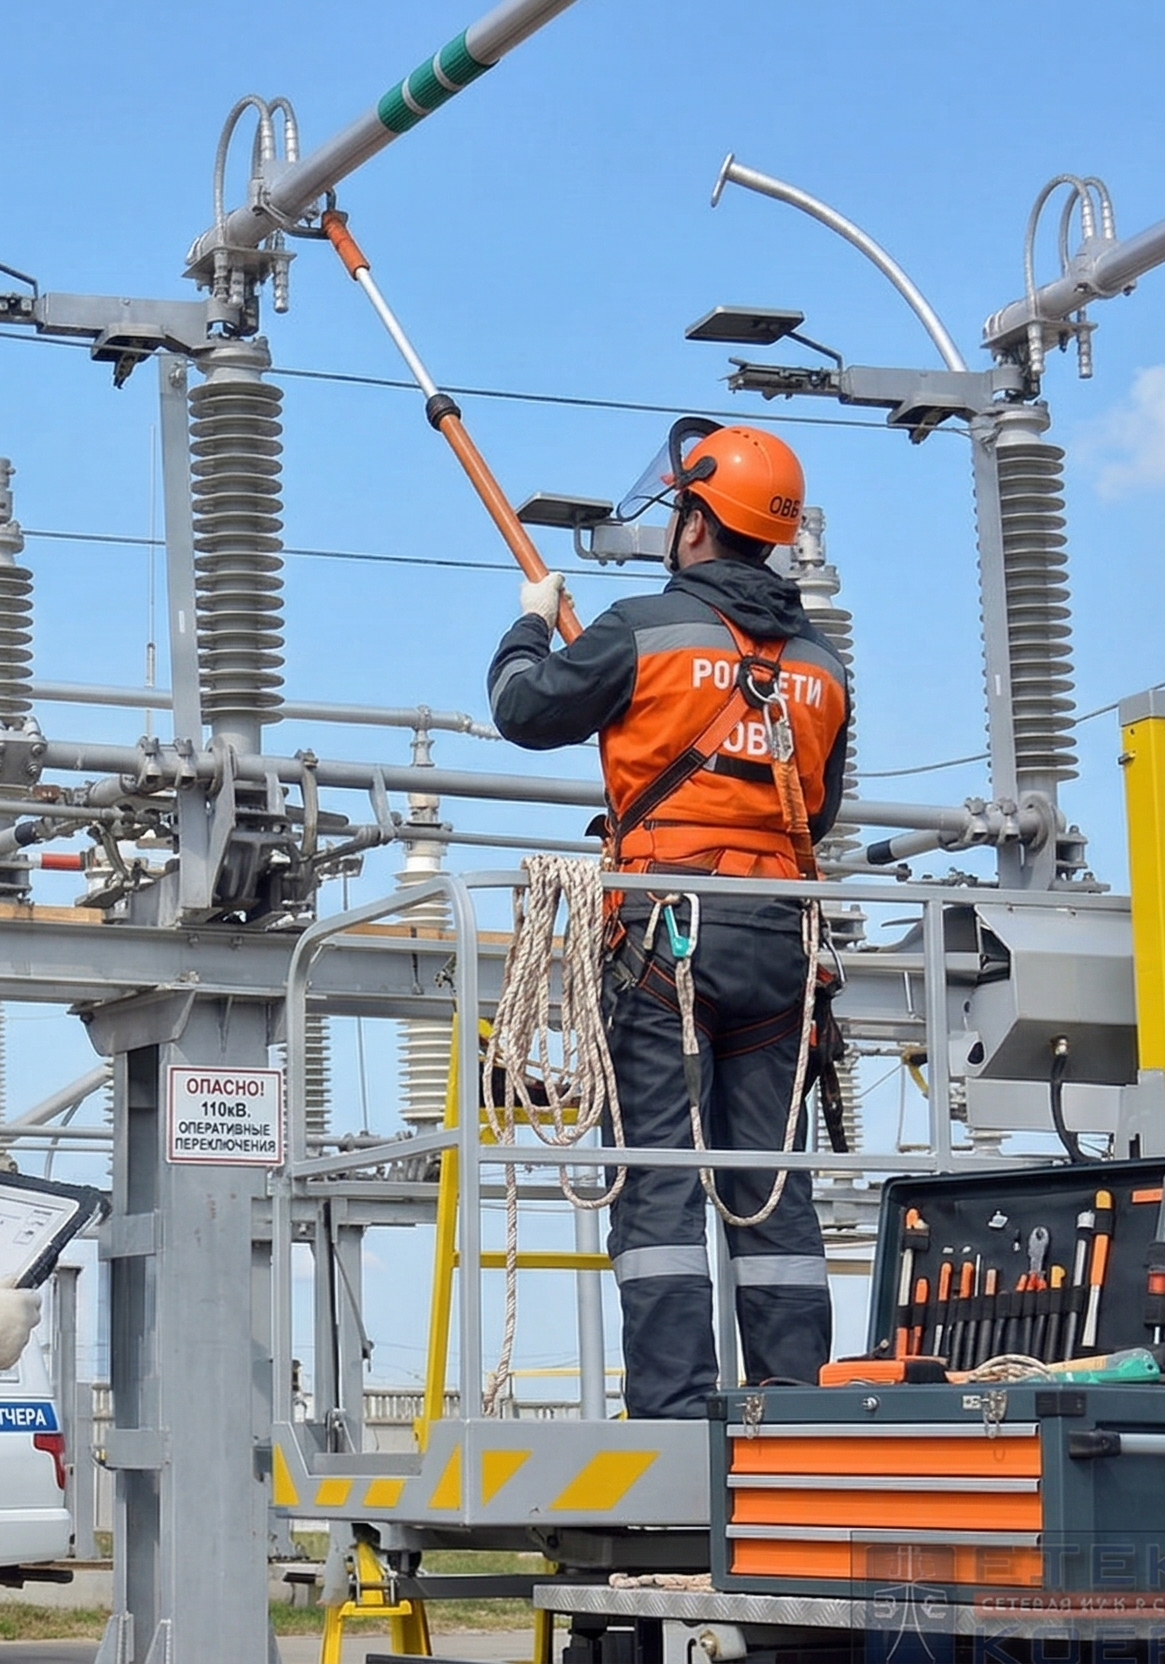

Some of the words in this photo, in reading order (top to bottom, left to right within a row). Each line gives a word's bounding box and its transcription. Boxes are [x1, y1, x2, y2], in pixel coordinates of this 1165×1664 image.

[693, 658, 821, 709] РОЕТИ
[723, 720, 789, 757] ОВ
[186, 1078, 265, 1097] ОПАСНО!
[201, 1101, 252, 1118] 110кВ.
[178, 1121, 271, 1136] ОПЕРАТИВНЫЕ
[175, 1137, 276, 1153] ПЕРЕКЛЮЧЕНИЯ
